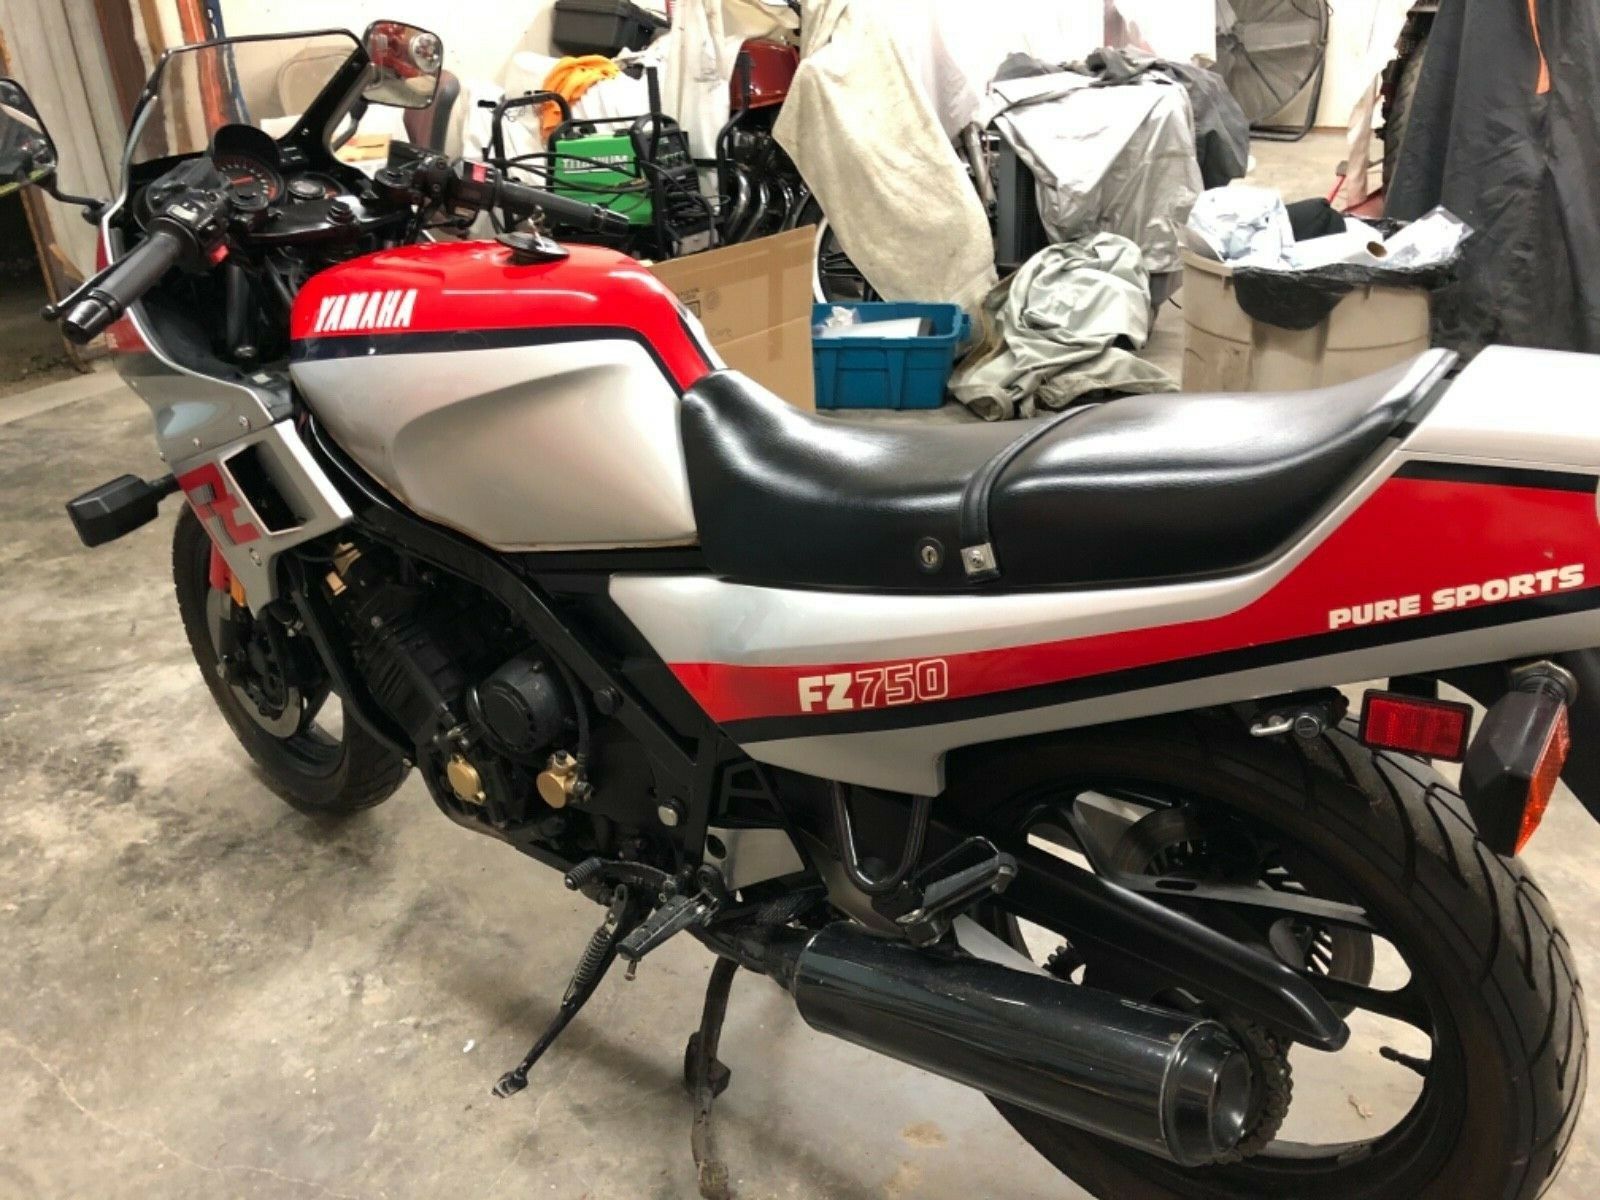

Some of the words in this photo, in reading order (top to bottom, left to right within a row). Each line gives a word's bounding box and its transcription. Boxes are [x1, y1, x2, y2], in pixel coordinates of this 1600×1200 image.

[313, 288, 418, 333] YAMAHA
[1328, 594, 1421, 630] PURE
[1431, 563, 1585, 612] SPORTS
[798, 658, 949, 712] FZ750
